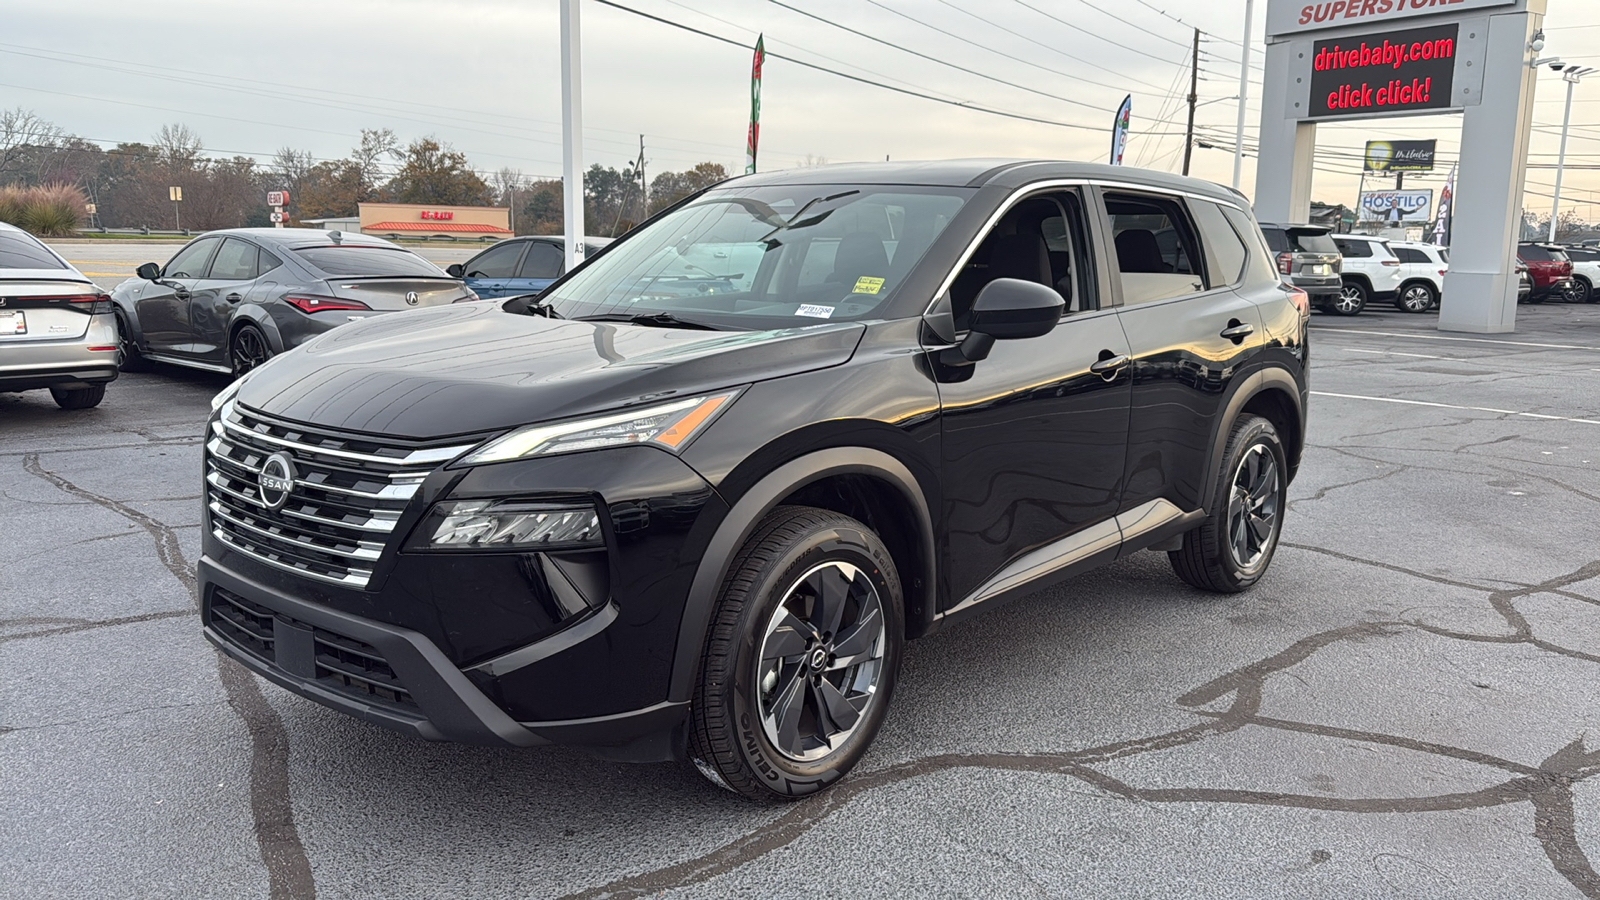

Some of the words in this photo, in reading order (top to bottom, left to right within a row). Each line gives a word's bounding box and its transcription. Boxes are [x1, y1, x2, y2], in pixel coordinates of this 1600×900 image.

[1298, 0, 1464, 25] SUPERSTO
[1314, 38, 1453, 71] drivebaby.com
[1327, 83, 1373, 110] click
[1376, 77, 1431, 106] click!
[1362, 196, 1427, 208] HOSTILO
[574, 242, 584, 254] A3
[262, 477, 291, 491] SSAN
[740, 712, 779, 781] CELIMO
